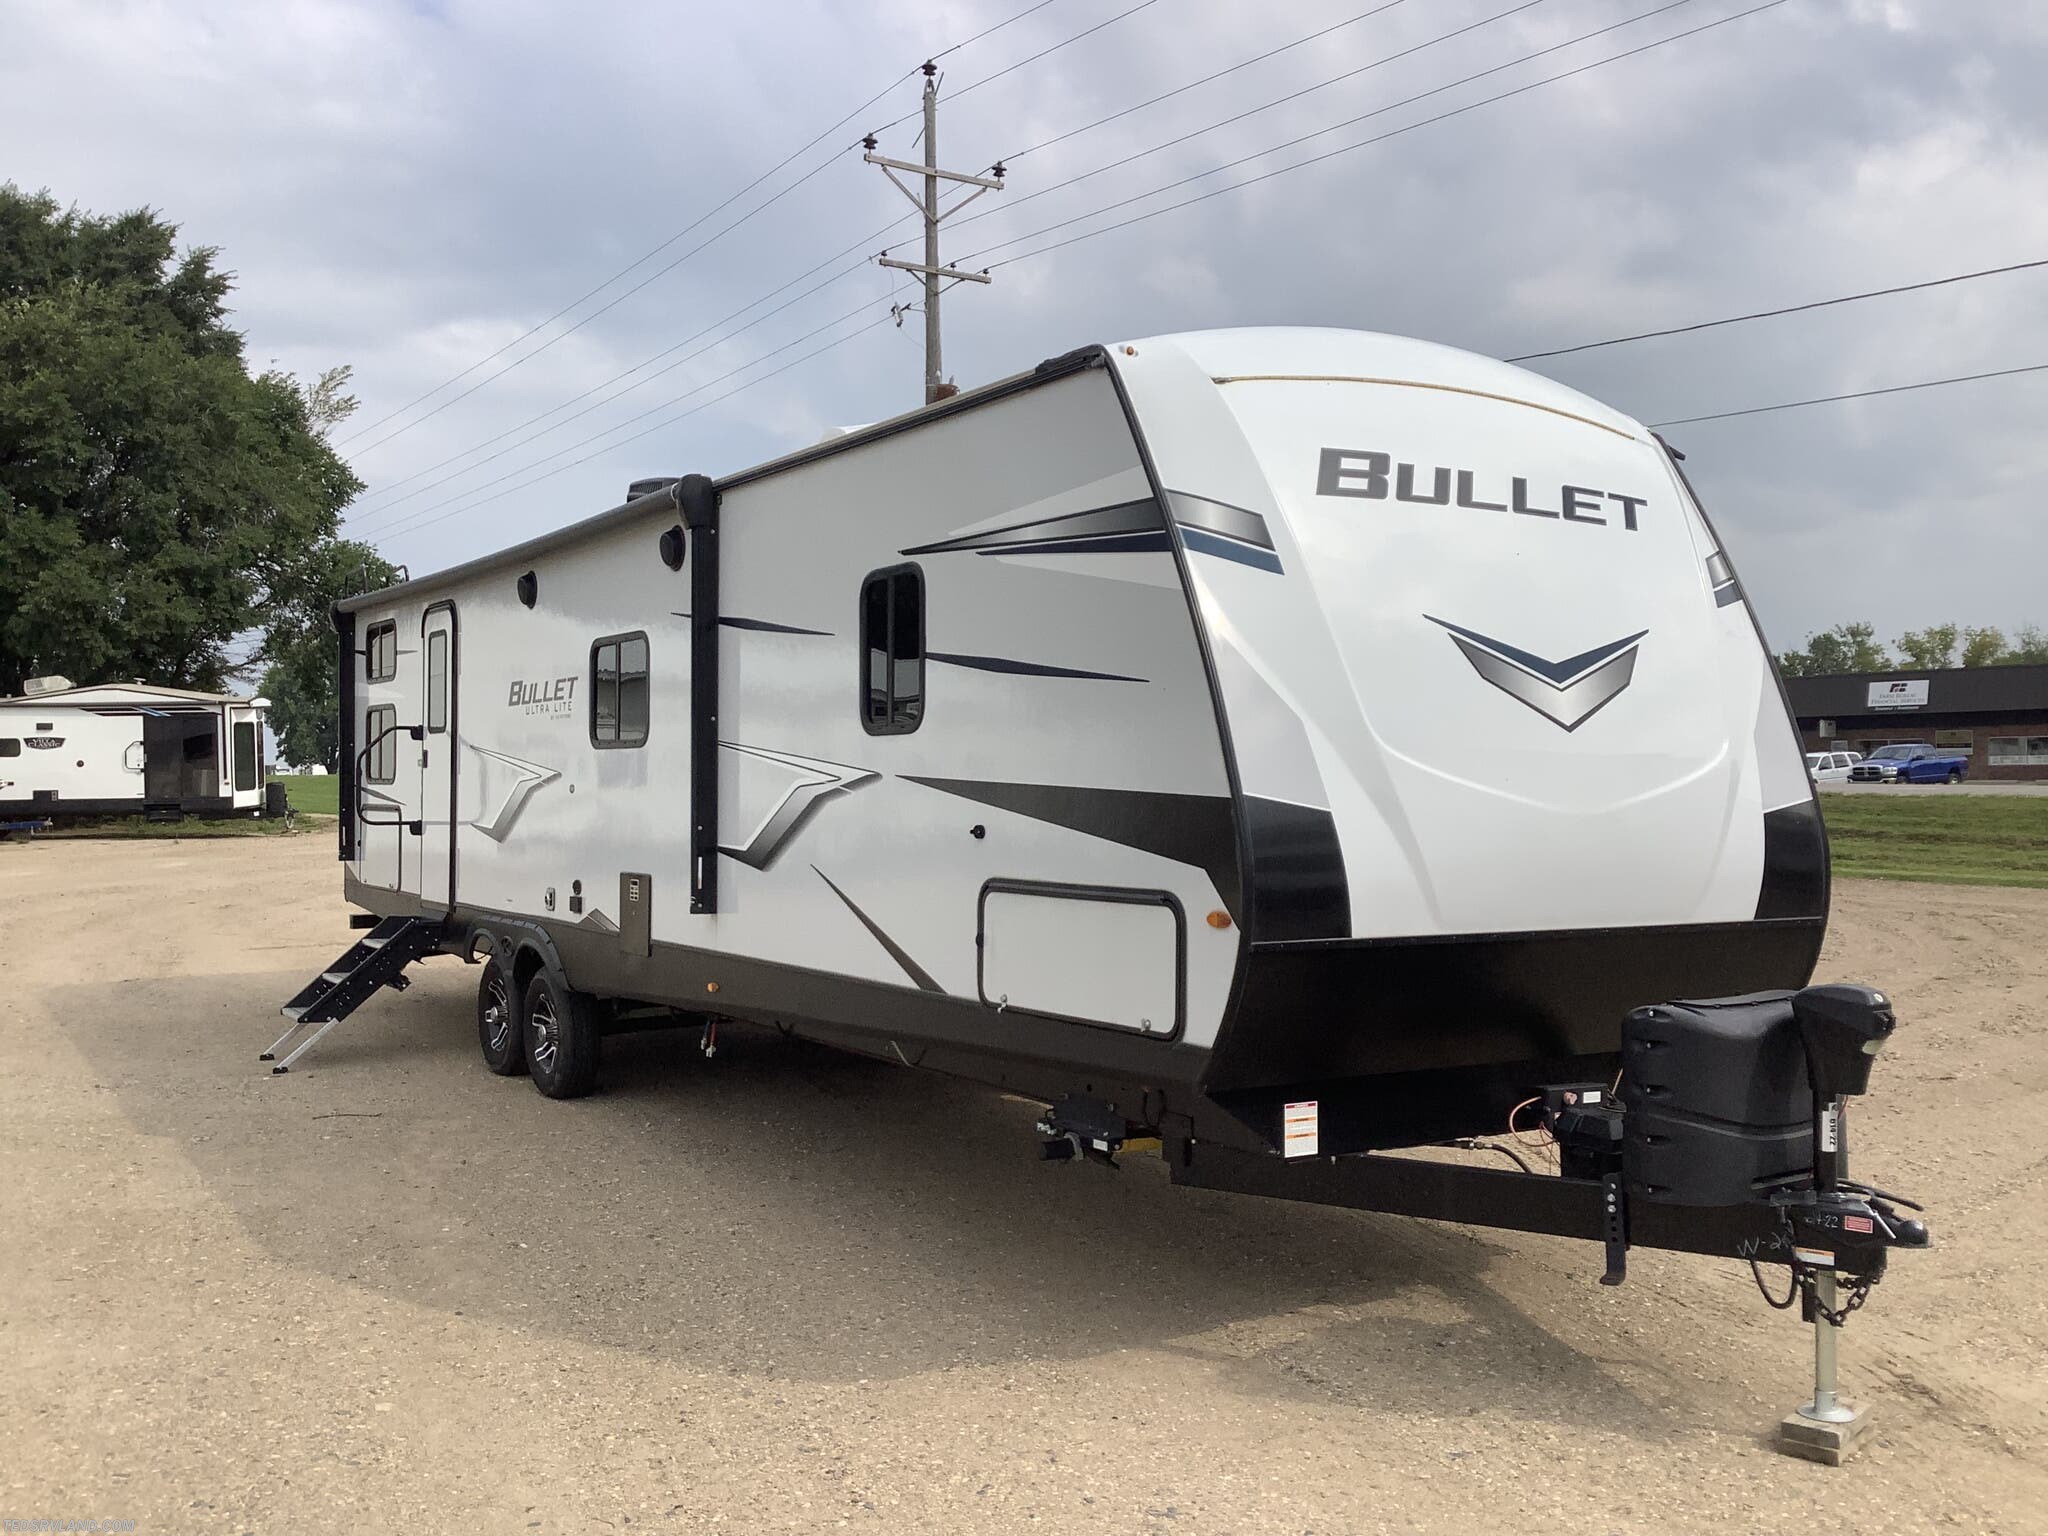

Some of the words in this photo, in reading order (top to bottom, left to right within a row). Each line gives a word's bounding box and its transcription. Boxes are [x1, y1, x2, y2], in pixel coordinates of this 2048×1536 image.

[1315, 447, 1648, 531] BULLET
[508, 676, 579, 706] BULLET
[525, 703, 550, 715] ULTRA
[554, 700, 572, 712] LITE
